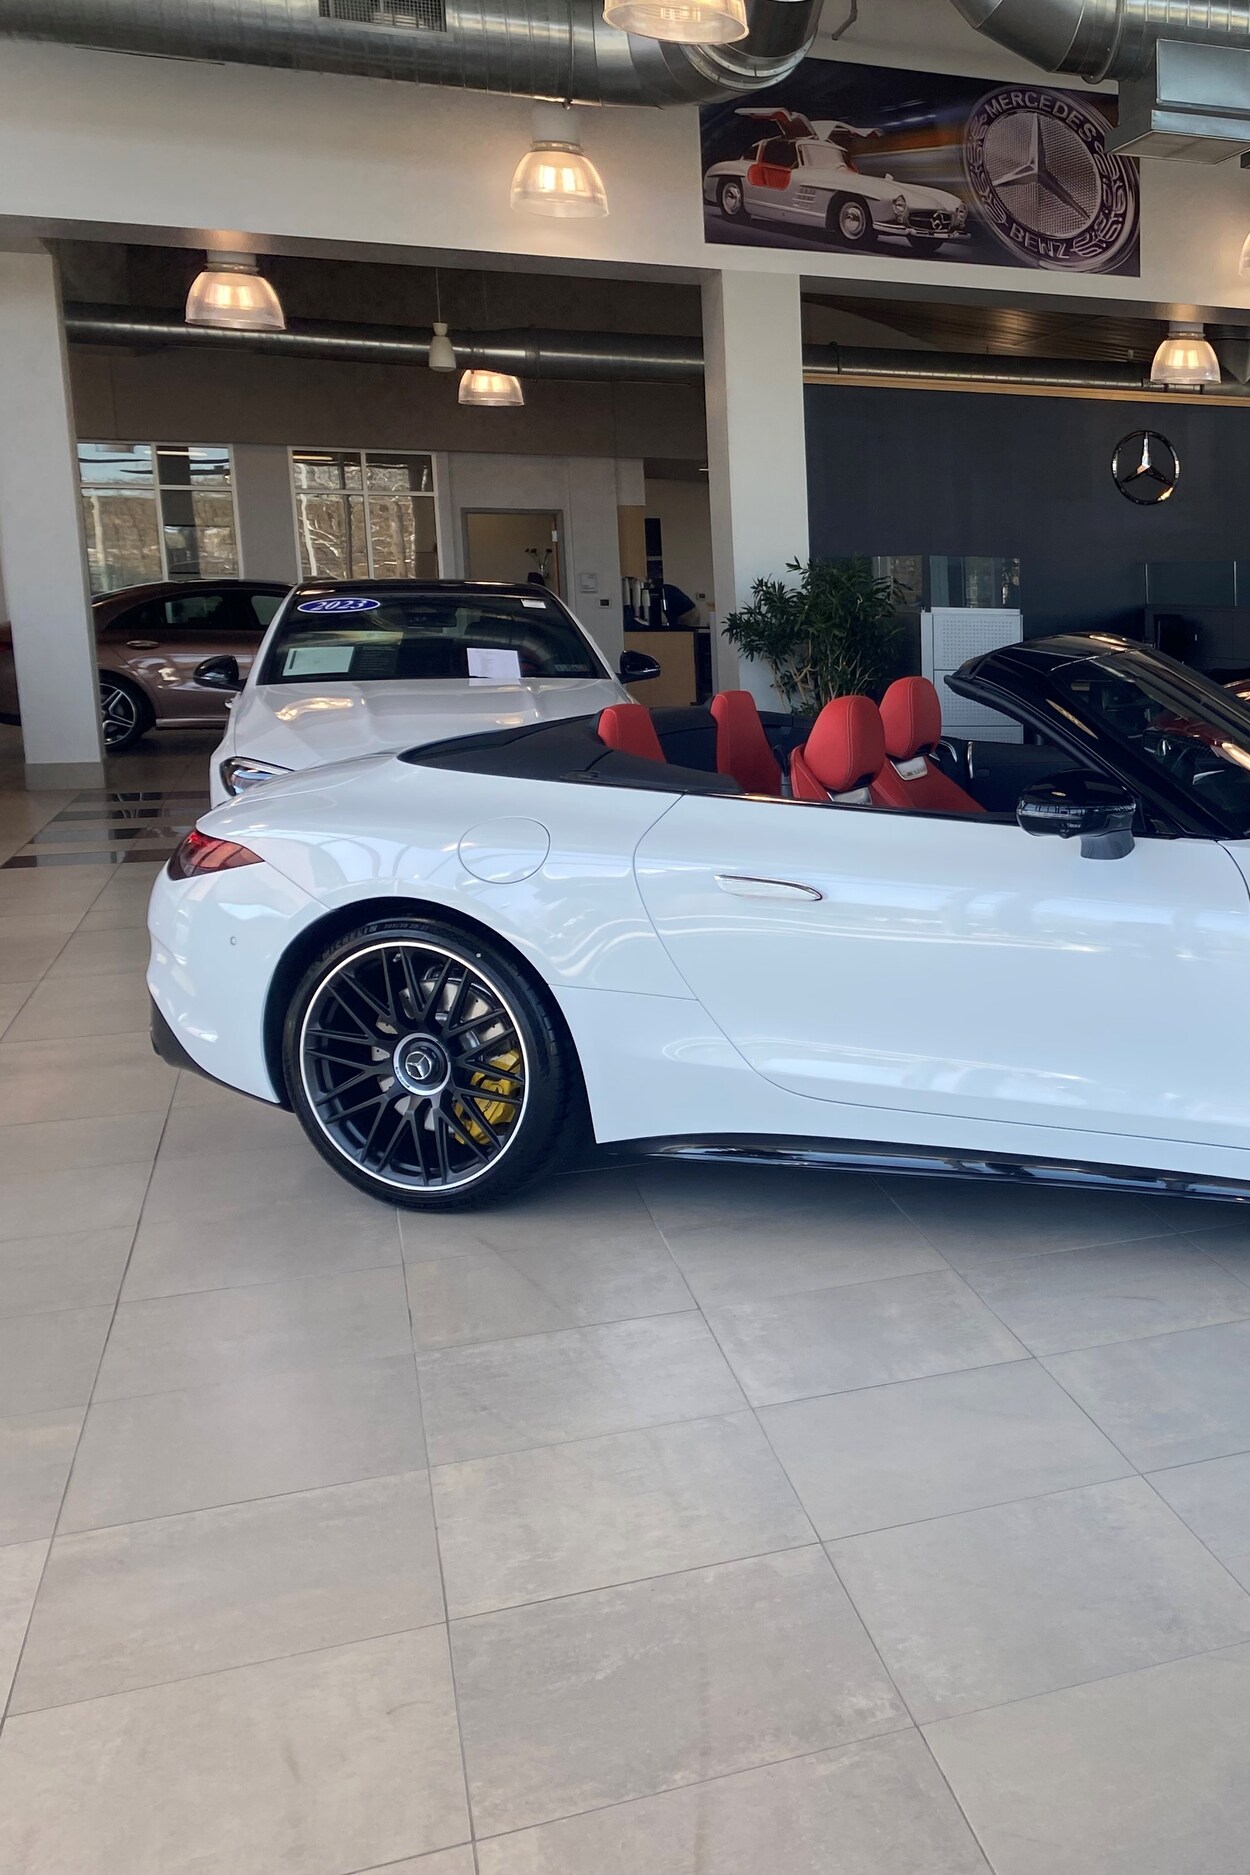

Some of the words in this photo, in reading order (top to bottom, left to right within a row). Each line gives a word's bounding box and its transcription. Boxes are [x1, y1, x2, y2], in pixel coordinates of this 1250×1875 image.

[985, 92, 1096, 142] MERCEDES
[1010, 226, 1070, 259] BENZ
[310, 600, 367, 611] 2023
